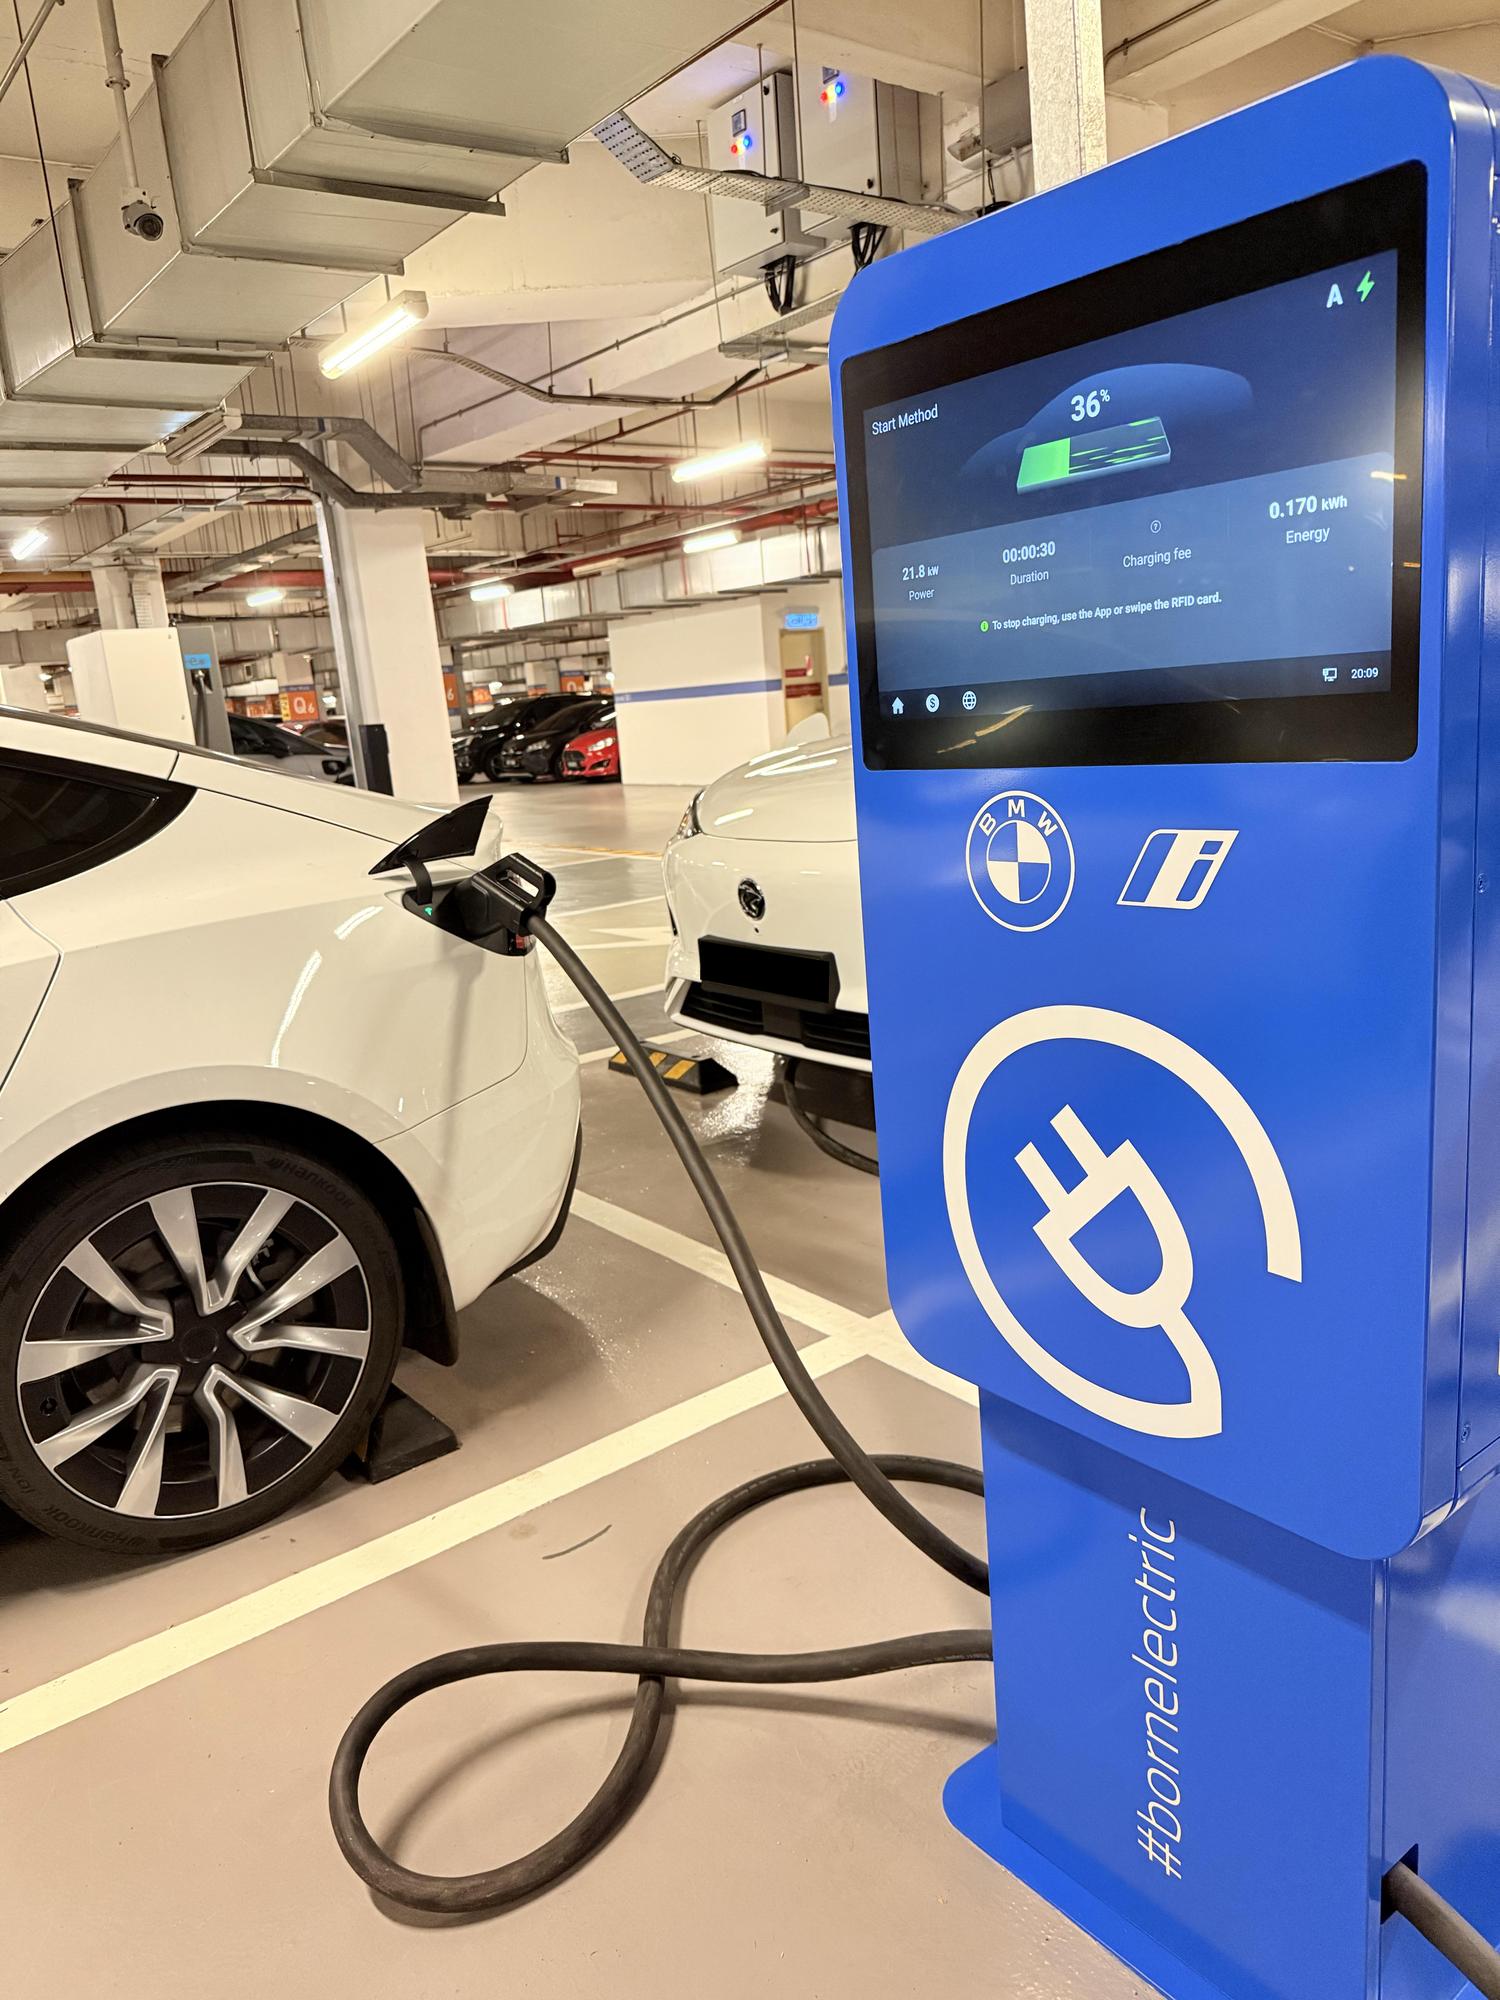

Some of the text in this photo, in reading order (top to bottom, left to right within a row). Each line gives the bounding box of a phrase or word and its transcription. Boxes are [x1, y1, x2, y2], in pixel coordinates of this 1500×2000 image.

[1326, 283, 1344, 309] A
[871, 403, 939, 436] Start Method
[1268, 495, 1348, 519] 0.170 kWh
[1285, 526, 1331, 544] Energy
[1002, 540, 1056, 564] 00:00:30
[1123, 546, 1192, 568] Charging fee
[902, 564, 940, 581] 21.8 kW
[1010, 570, 1049, 586] Duration
[908, 588, 935, 601] Power
[992, 591, 1222, 631] To stop charging, use the App or swipe the RFID card.
[1351, 667, 1379, 679] 20:09
[978, 799, 1058, 837] BMW
[1128, 1506, 1182, 1880] #bornelectric
